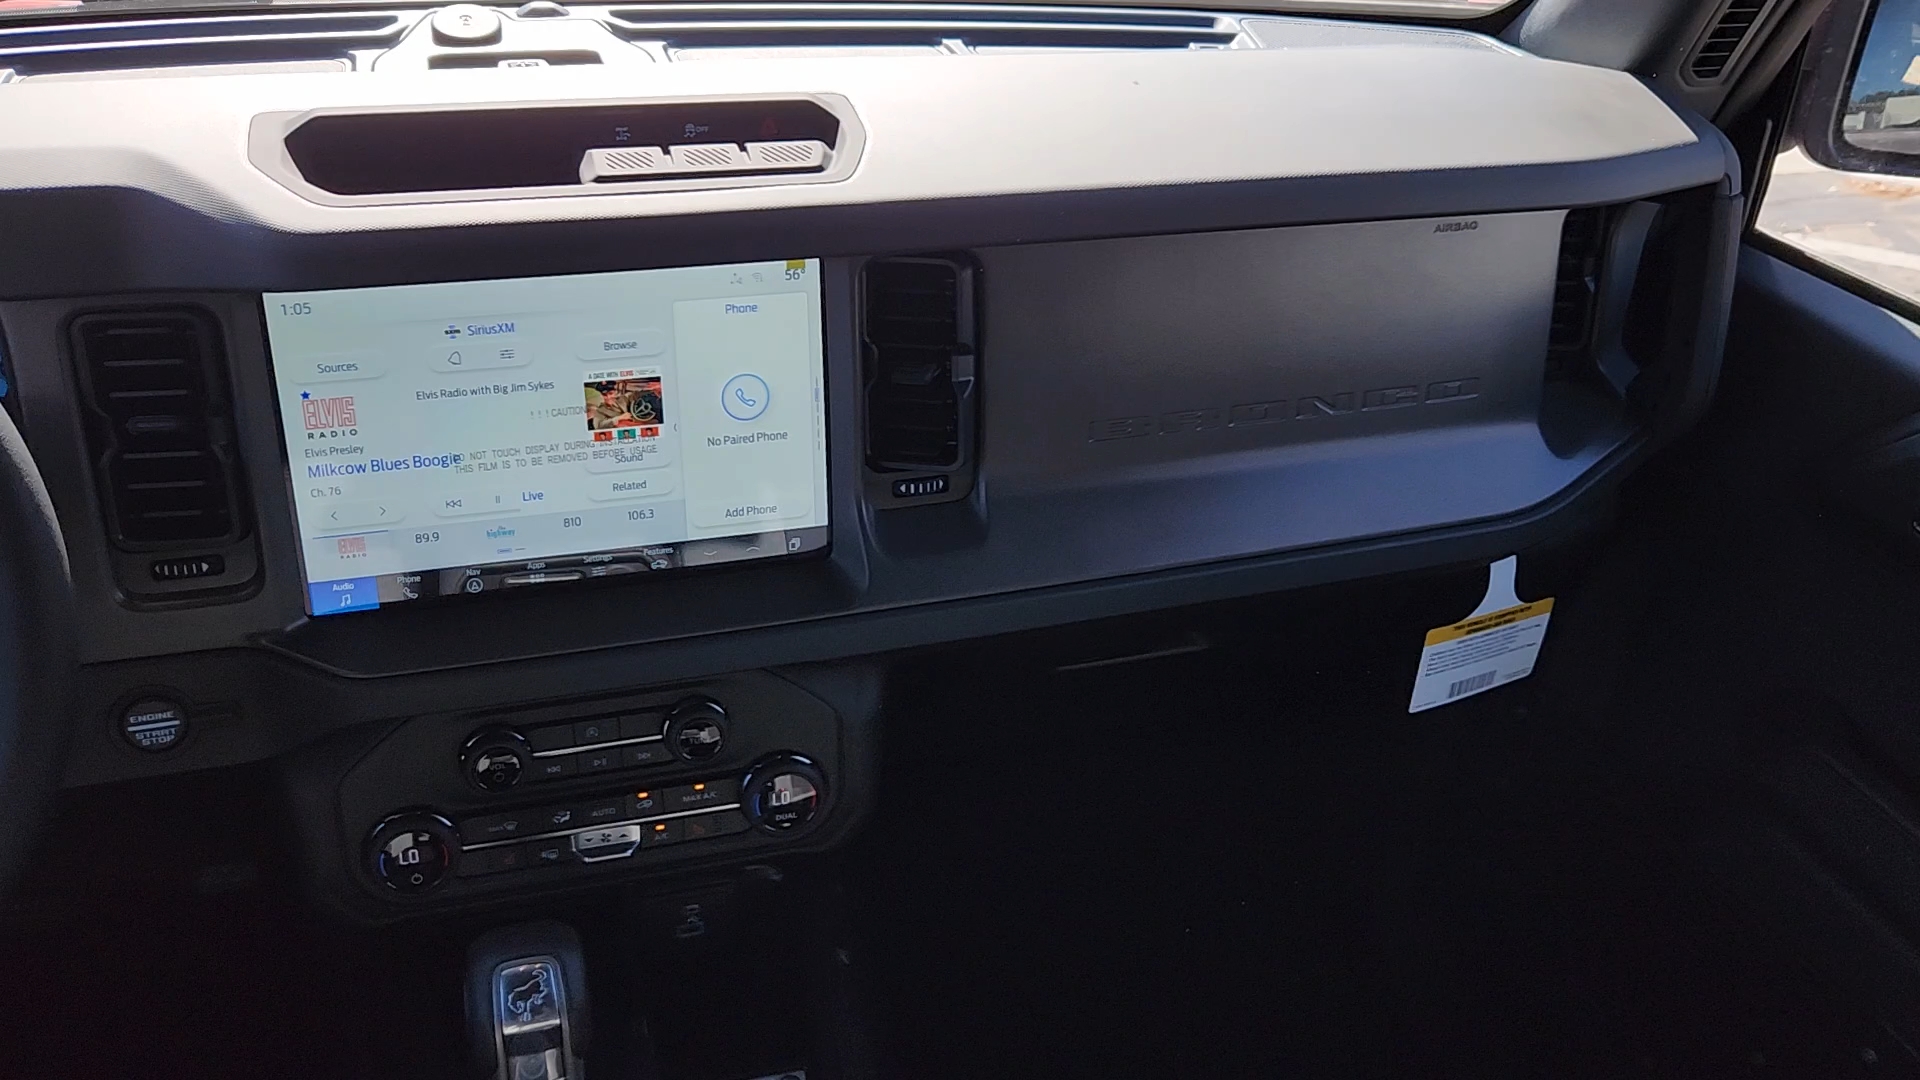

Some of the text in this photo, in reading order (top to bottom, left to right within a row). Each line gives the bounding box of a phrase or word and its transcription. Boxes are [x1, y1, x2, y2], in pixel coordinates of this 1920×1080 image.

[280, 302, 312, 316] 1:05
[725, 303, 758, 314] Phone
[467, 322, 515, 336] SiriusXM
[603, 340, 638, 351] Browse
[316, 361, 358, 374] Sources
[416, 380, 555, 400] Elvis Radio with Big Jim Sykes
[302, 397, 357, 429] ELVIS
[307, 429, 358, 439] RADIO
[707, 431, 788, 447] No Paired Phone
[305, 445, 364, 459] Elvis Presley
[470, 450, 487, 460] NOT
[492, 447, 521, 458] TOUCH
[526, 443, 560, 455] DISPLAY
[564, 440, 596, 451] DURING
[454, 445, 658, 474] THIS FILM IS TO BE REMOVED BEFORE USAGE
[614, 453, 643, 464] Sound
[308, 452, 462, 478] Milkcow Blues Boogie
[612, 480, 647, 492] Related
[310, 486, 342, 498] Ch. 76
[522, 491, 544, 502] Live
[627, 509, 655, 521] 106.3
[725, 504, 778, 518] Add Phone
[563, 517, 582, 528] 810
[415, 532, 440, 544] 89.9
[643, 547, 674, 556] Features
[583, 555, 613, 564] Settings
[527, 562, 546, 571] Apps
[466, 569, 482, 577] Nav
[396, 575, 421, 584] Phone
[332, 583, 355, 592] Audio
[129, 711, 174, 723] ENGINE
[135, 728, 176, 739] START
[142, 735, 174, 746] STOP
[592, 807, 616, 817] AUTO
[775, 812, 798, 822] DUAL
